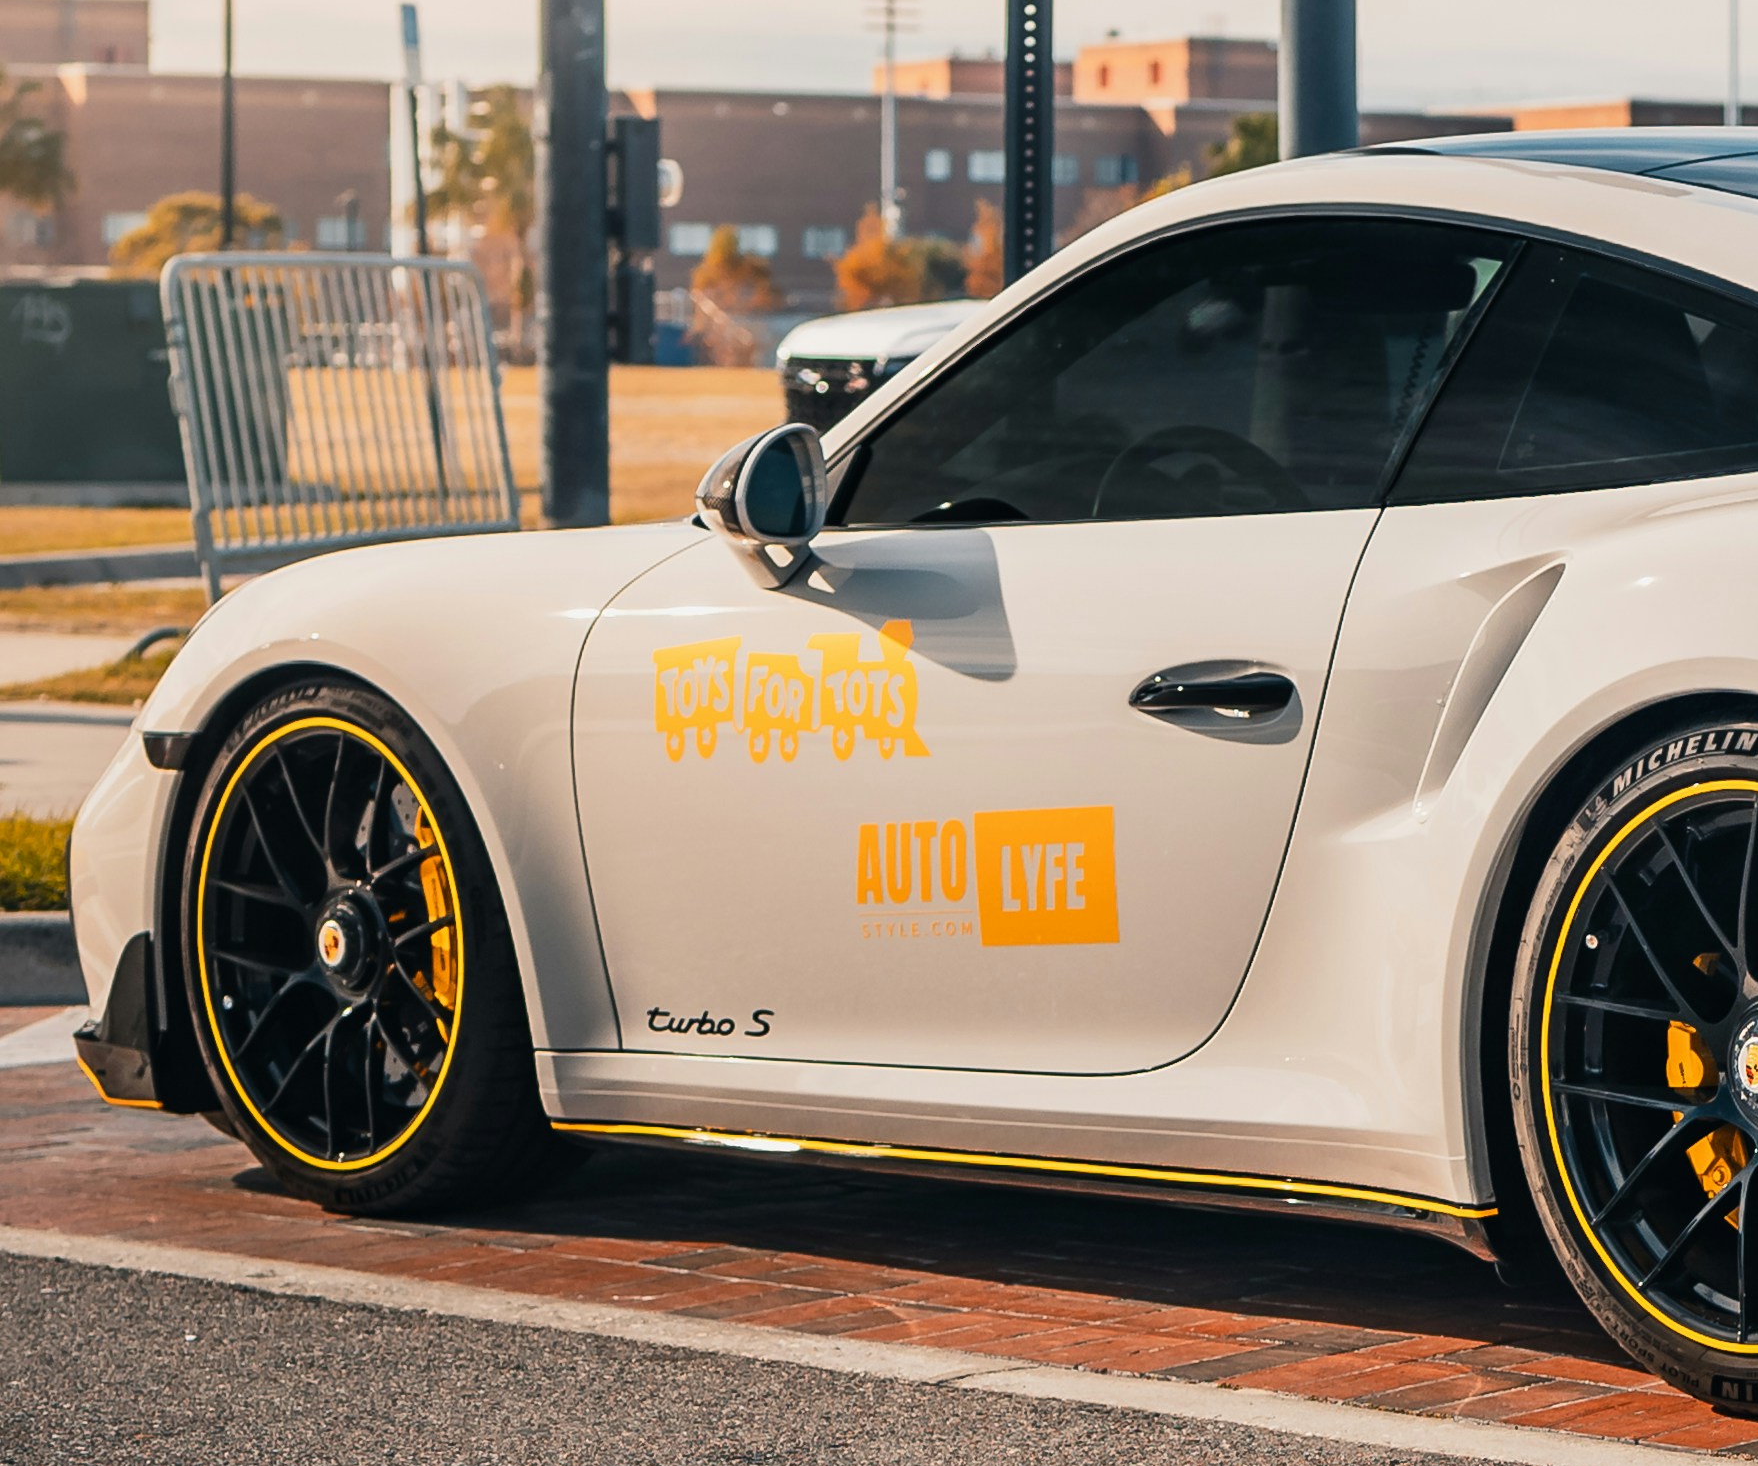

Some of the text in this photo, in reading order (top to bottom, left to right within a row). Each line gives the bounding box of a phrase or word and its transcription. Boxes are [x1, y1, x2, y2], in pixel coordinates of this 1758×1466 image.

[660, 654, 731, 719] TOYS
[747, 665, 804, 724] FOR
[825, 668, 905, 728] TOTS
[857, 819, 967, 905] AUTO
[1001, 841, 1086, 912] LYFE
[862, 921, 974, 939] STYLE.COM
[647, 1006, 775, 1037] turbo S
[1612, 1319, 1656, 1364] SPORT
[1660, 1361, 1699, 1388] PILOT
